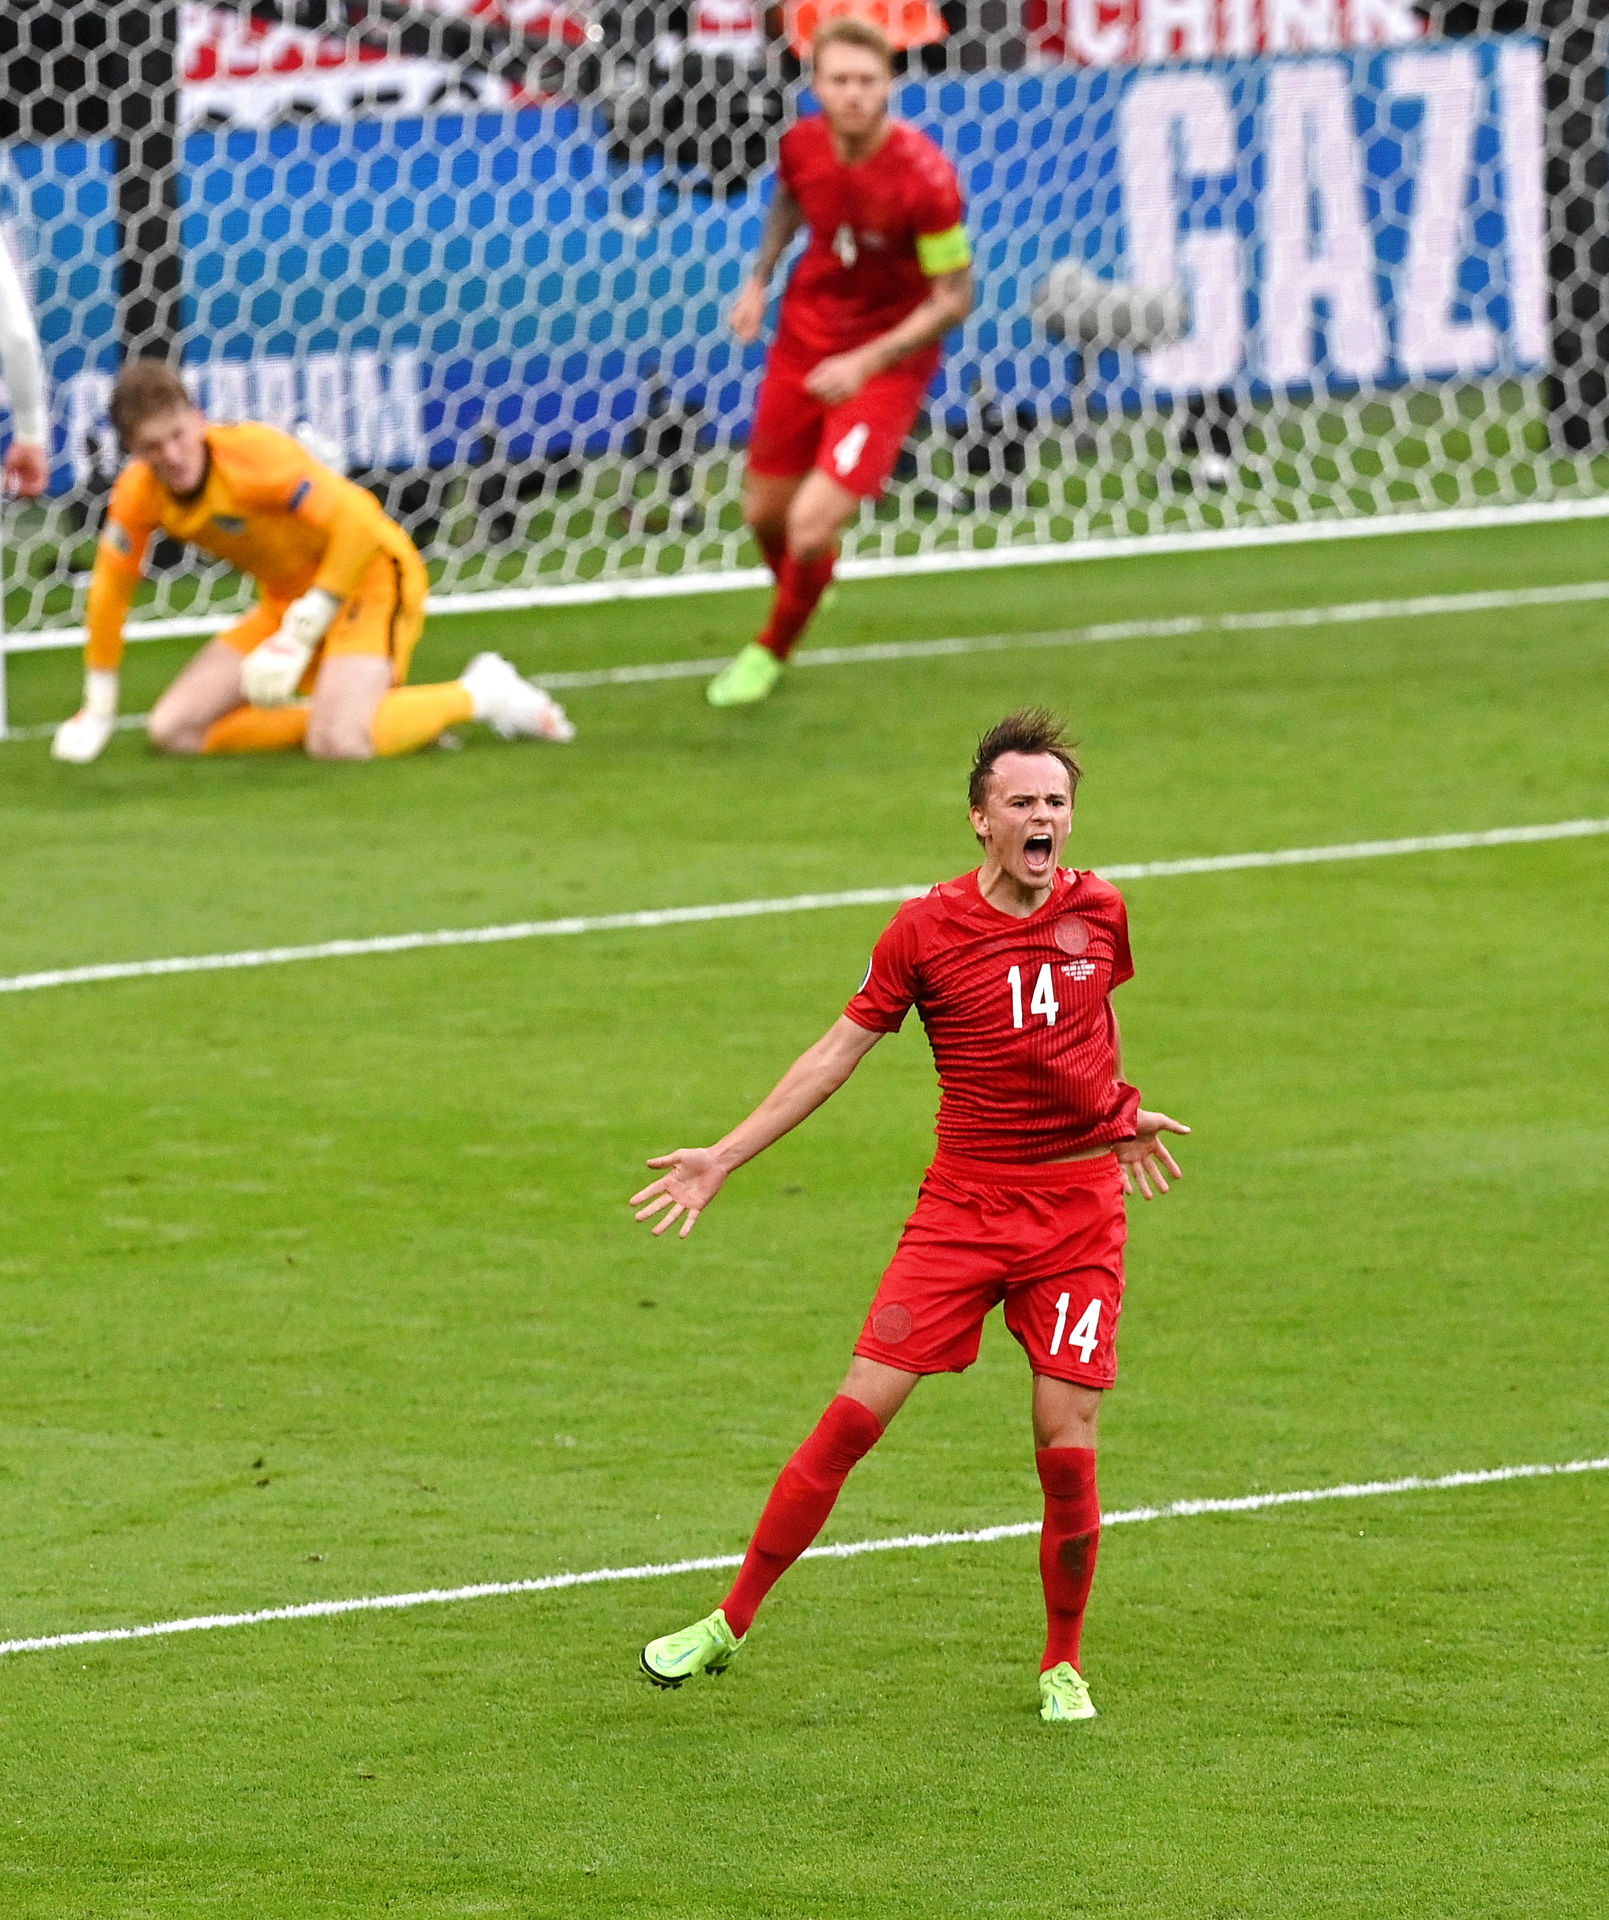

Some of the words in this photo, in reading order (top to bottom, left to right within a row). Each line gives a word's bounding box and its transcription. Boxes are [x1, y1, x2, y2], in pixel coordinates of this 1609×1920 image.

[833, 423, 870, 477] 4
[1007, 963, 1059, 1028] 14
[1050, 1292, 1102, 1363] 14
